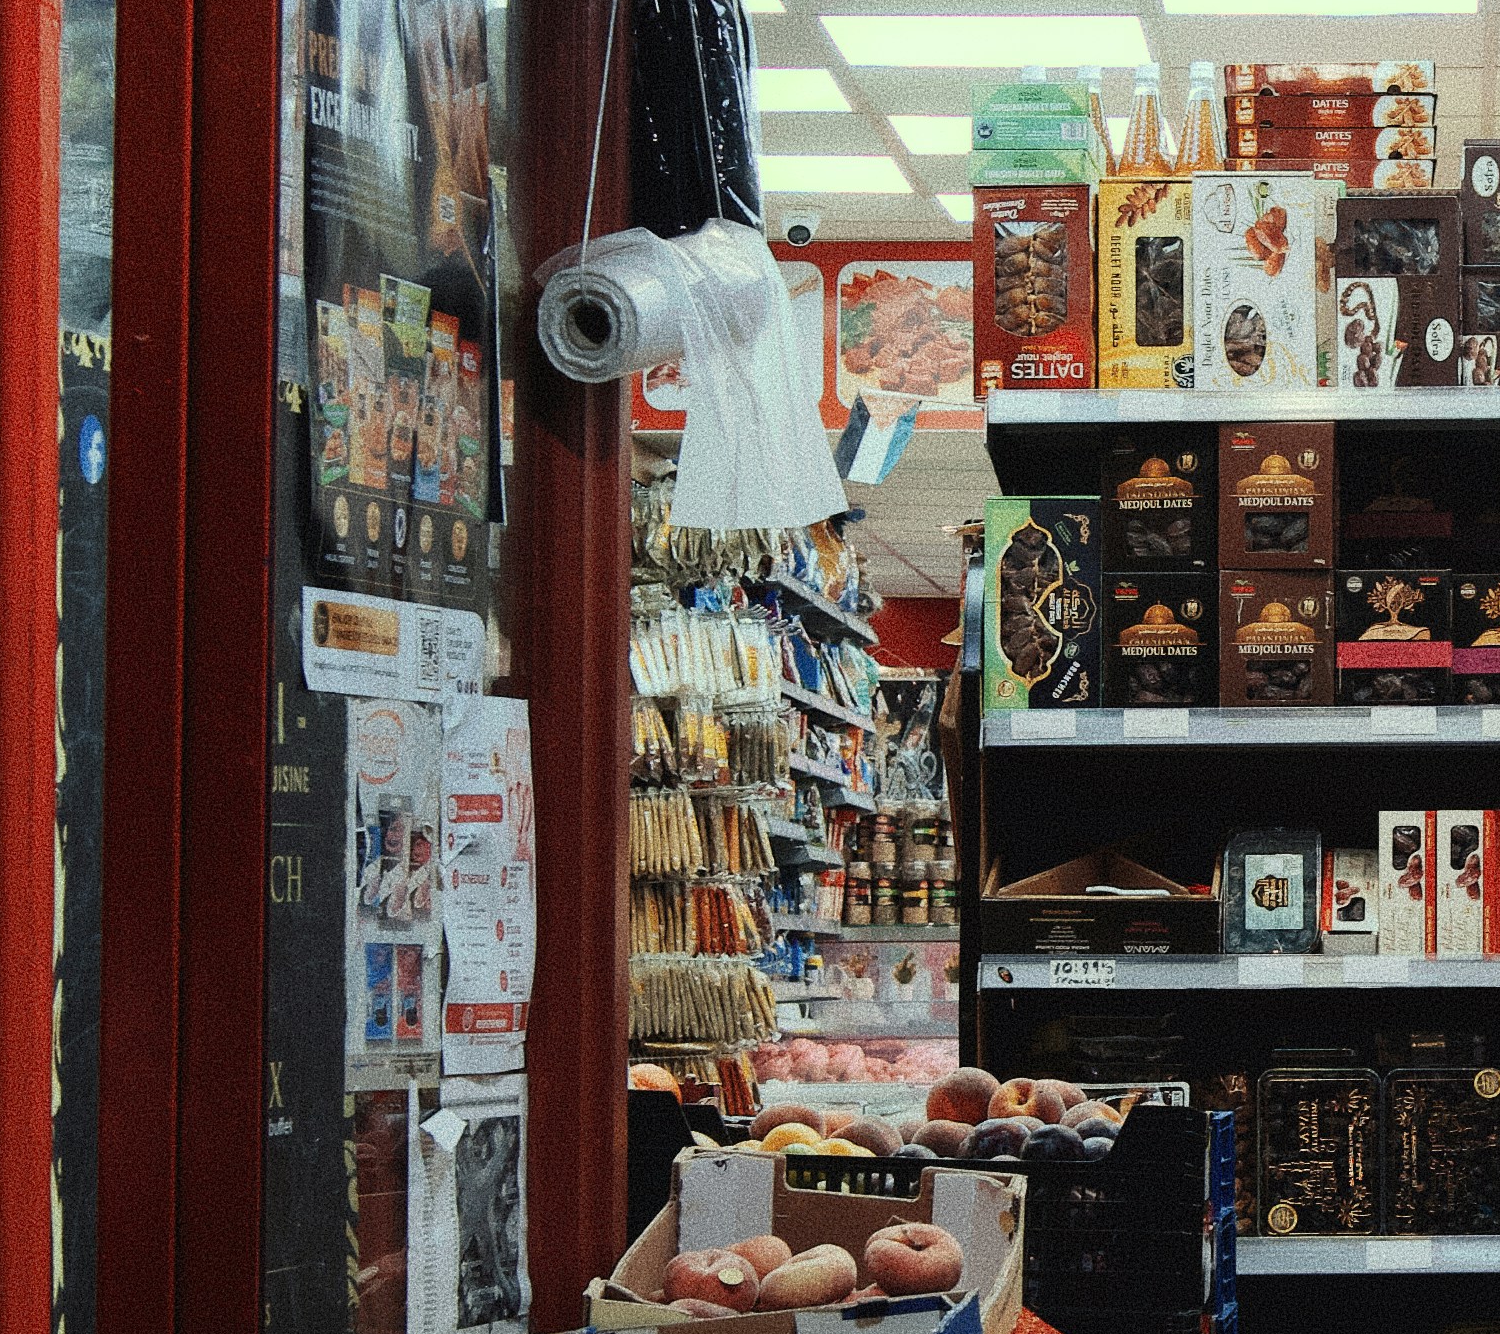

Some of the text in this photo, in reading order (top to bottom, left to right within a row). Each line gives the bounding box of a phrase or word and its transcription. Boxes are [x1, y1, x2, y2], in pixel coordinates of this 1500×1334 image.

[1312, 99, 1349, 108] DATTES
[1315, 131, 1352, 140] DATTES
[1313, 163, 1350, 172] DATTES
[1110, 235, 1122, 269] DEGLET
[1431, 321, 1445, 357] Sofra
[1202, 334, 1212, 368] Deglet
[1015, 351, 1073, 363] deglet nour
[1010, 362, 1085, 379] DATTES
[1119, 498, 1193, 509] MEDJOUL DATES
[1238, 497, 1314, 508] MEDJOUL DATES
[1121, 646, 1198, 657] MEDJOUL DATES
[1238, 644, 1314, 655] MEDJOUL DATES
